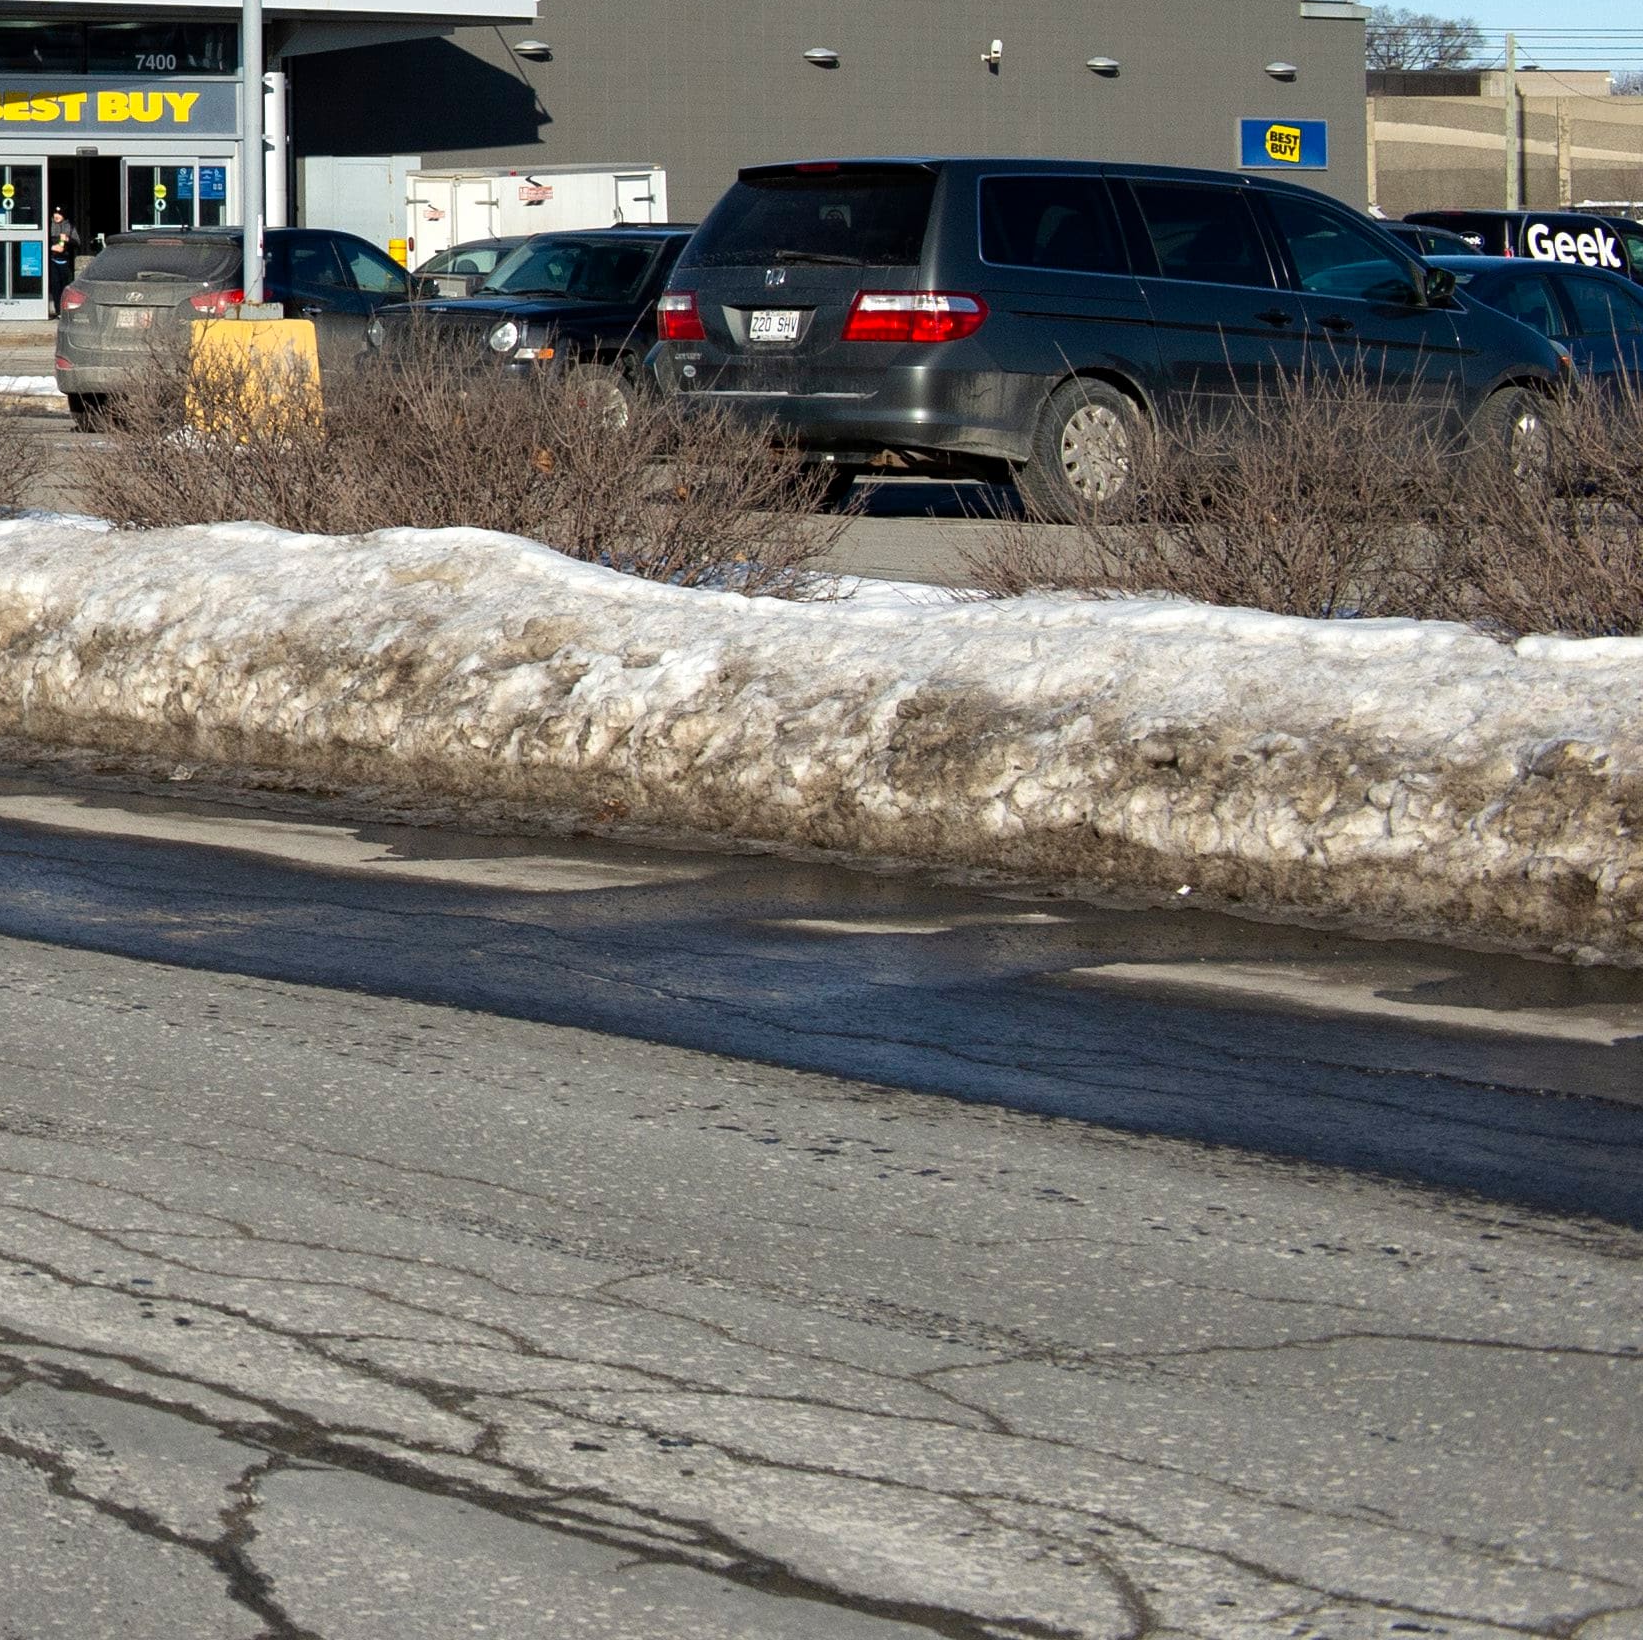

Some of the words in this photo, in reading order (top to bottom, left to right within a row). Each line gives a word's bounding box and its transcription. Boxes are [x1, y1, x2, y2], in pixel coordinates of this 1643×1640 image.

[135, 54, 176, 70] 7400
[97, 91, 200, 122] BUY
[1270, 131, 1299, 146] BEST
[1270, 143, 1296, 156] BUY
[1527, 223, 1621, 267] Geek
[777, 316, 797, 332] SHV
